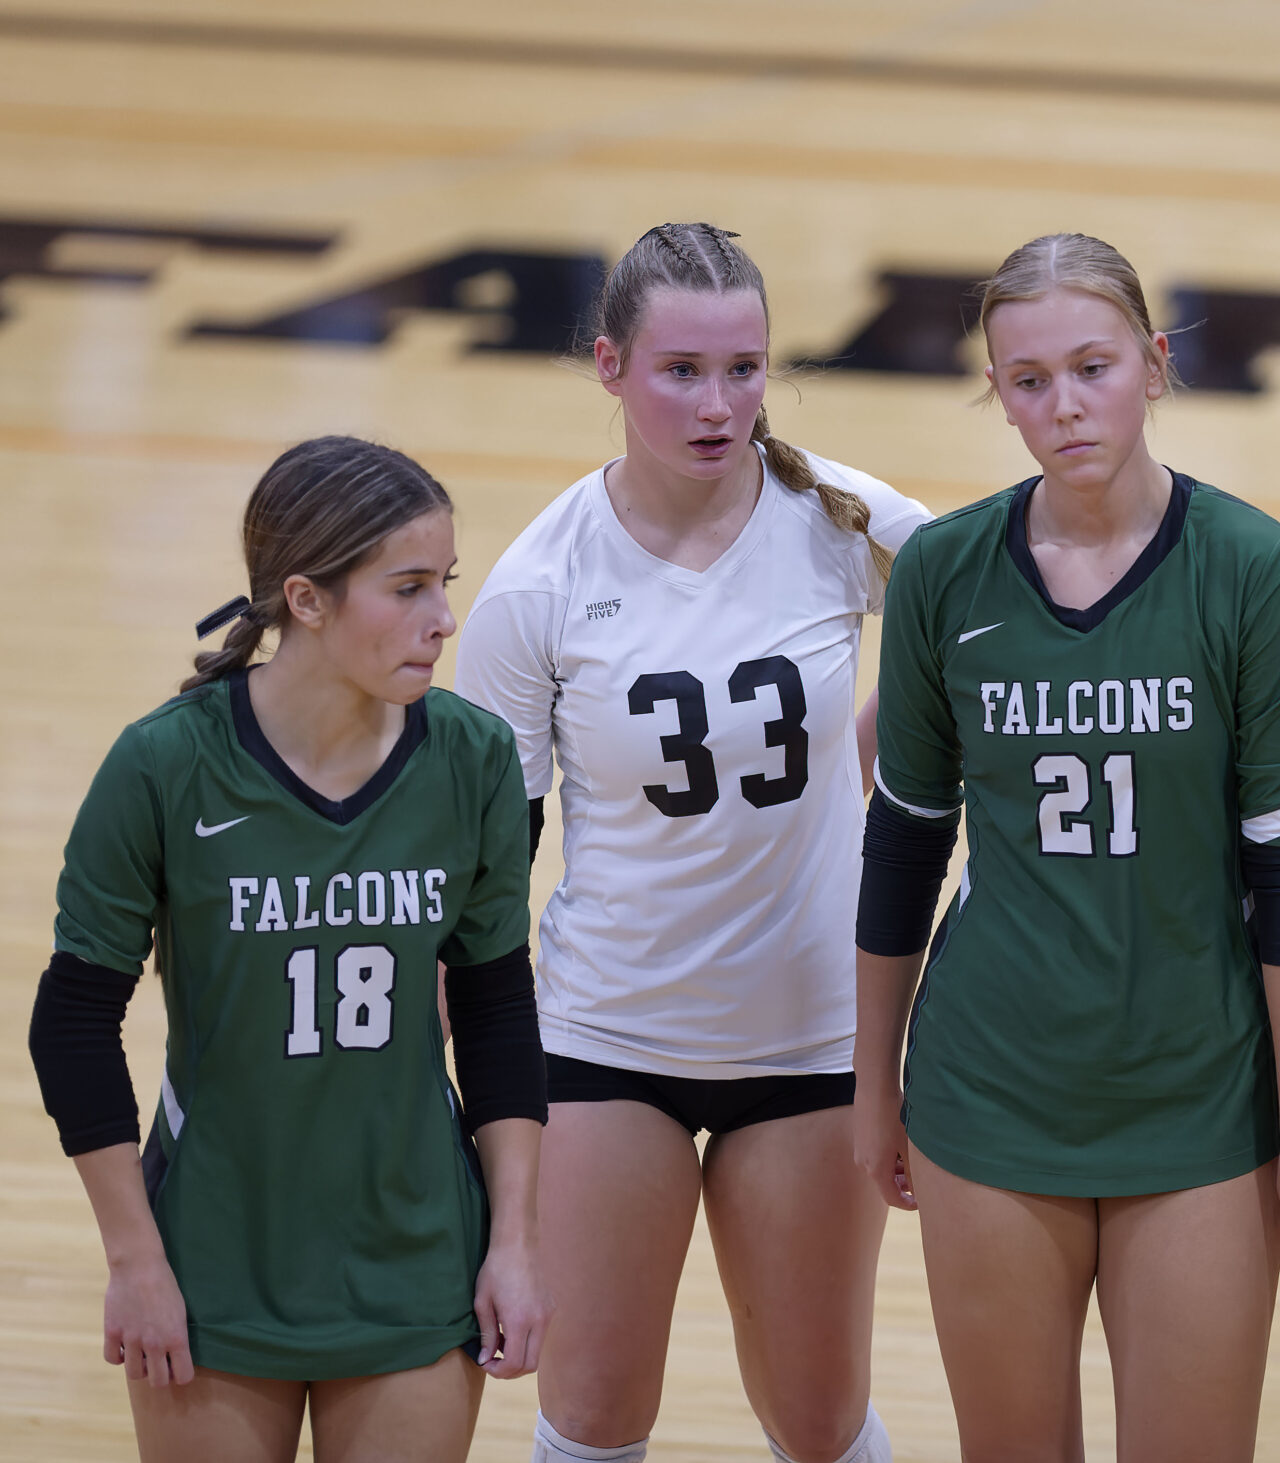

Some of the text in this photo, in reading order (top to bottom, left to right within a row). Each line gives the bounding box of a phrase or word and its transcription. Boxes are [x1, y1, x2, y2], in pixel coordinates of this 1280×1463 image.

[586, 600, 612, 612] HIGH
[587, 609, 613, 621] FIVE
[627, 654, 808, 818] 33
[980, 676, 1194, 735] FALCONS
[1031, 752, 1140, 858] 21
[228, 868, 447, 932] FALCONS
[284, 943, 398, 1059] 18
